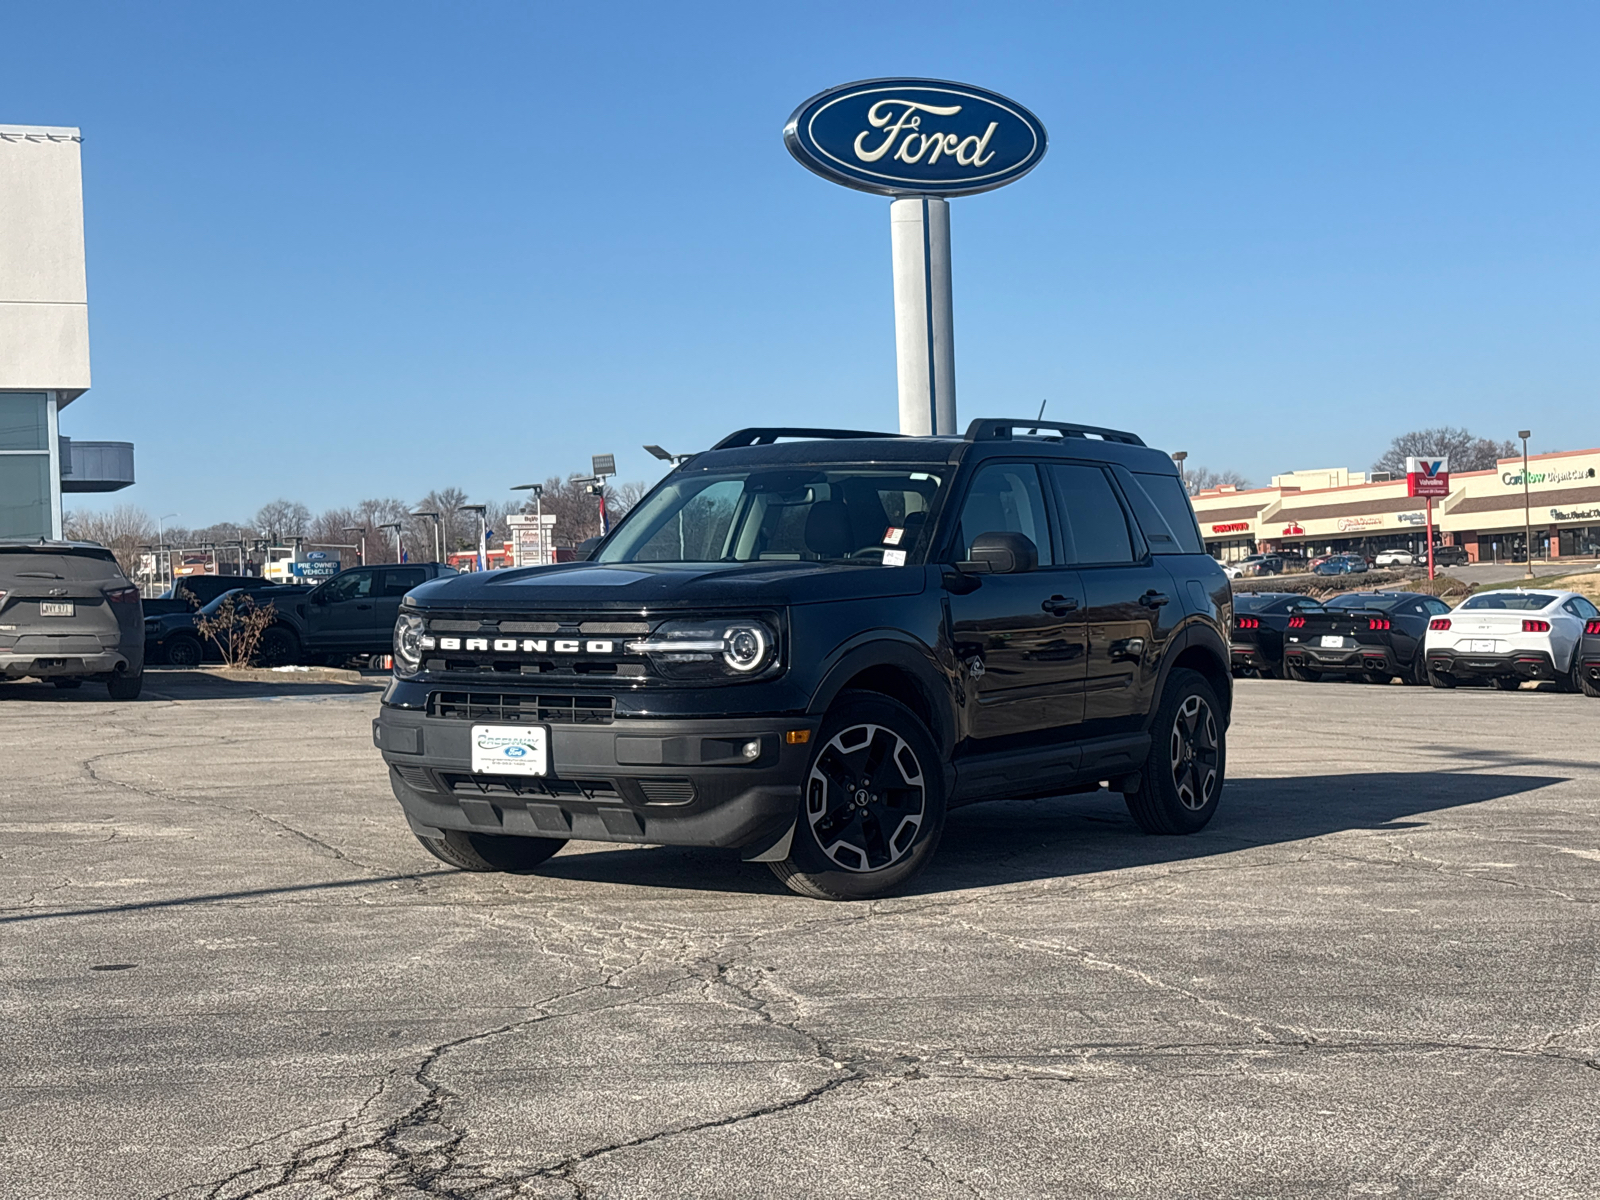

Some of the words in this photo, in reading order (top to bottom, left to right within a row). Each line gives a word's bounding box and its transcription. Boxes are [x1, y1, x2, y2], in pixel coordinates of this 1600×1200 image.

[854, 99, 998, 167] Ford
[440, 638, 613, 652] BRONCO
[508, 747, 523, 756] Ford
